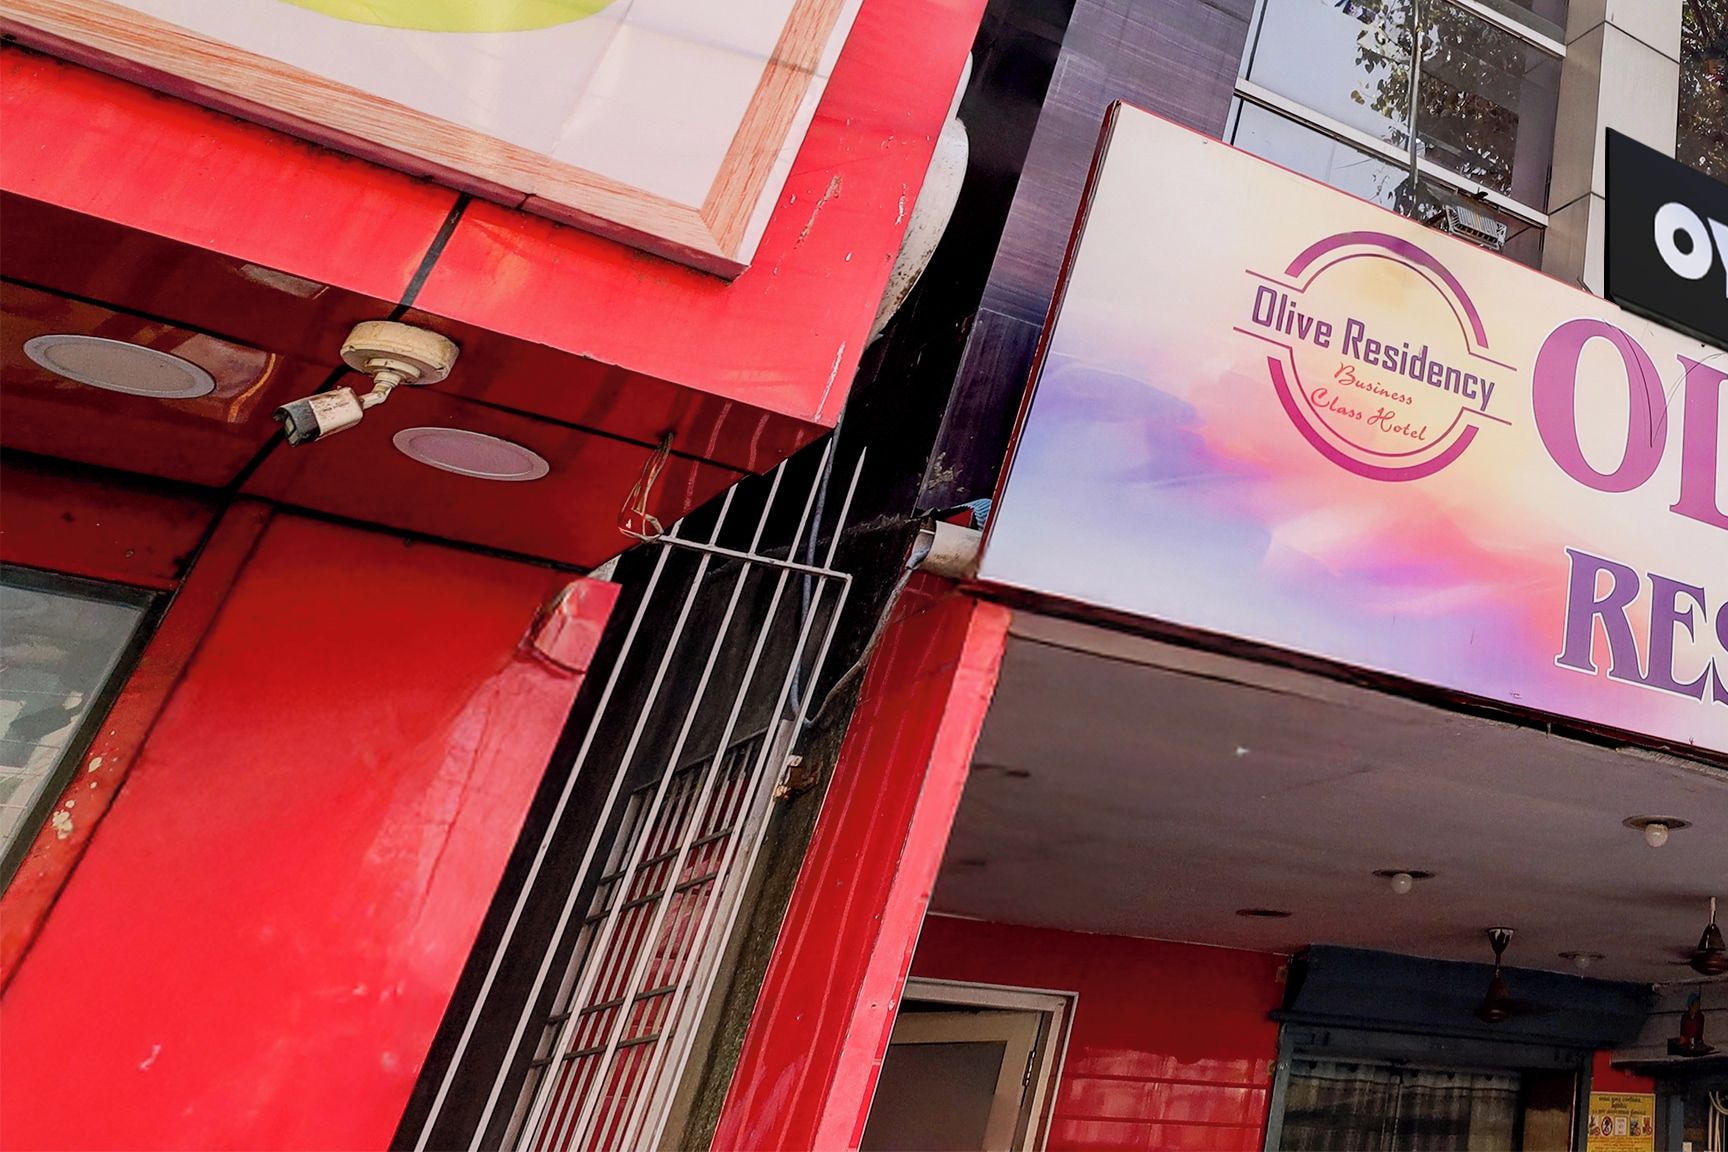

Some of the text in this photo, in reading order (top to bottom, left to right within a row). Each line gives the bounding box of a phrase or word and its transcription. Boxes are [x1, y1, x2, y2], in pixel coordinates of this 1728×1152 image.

[1251, 285, 1495, 411] Olive Residency
[1333, 362, 1413, 406] Business
[1310, 387, 1427, 441] Class Hotel
